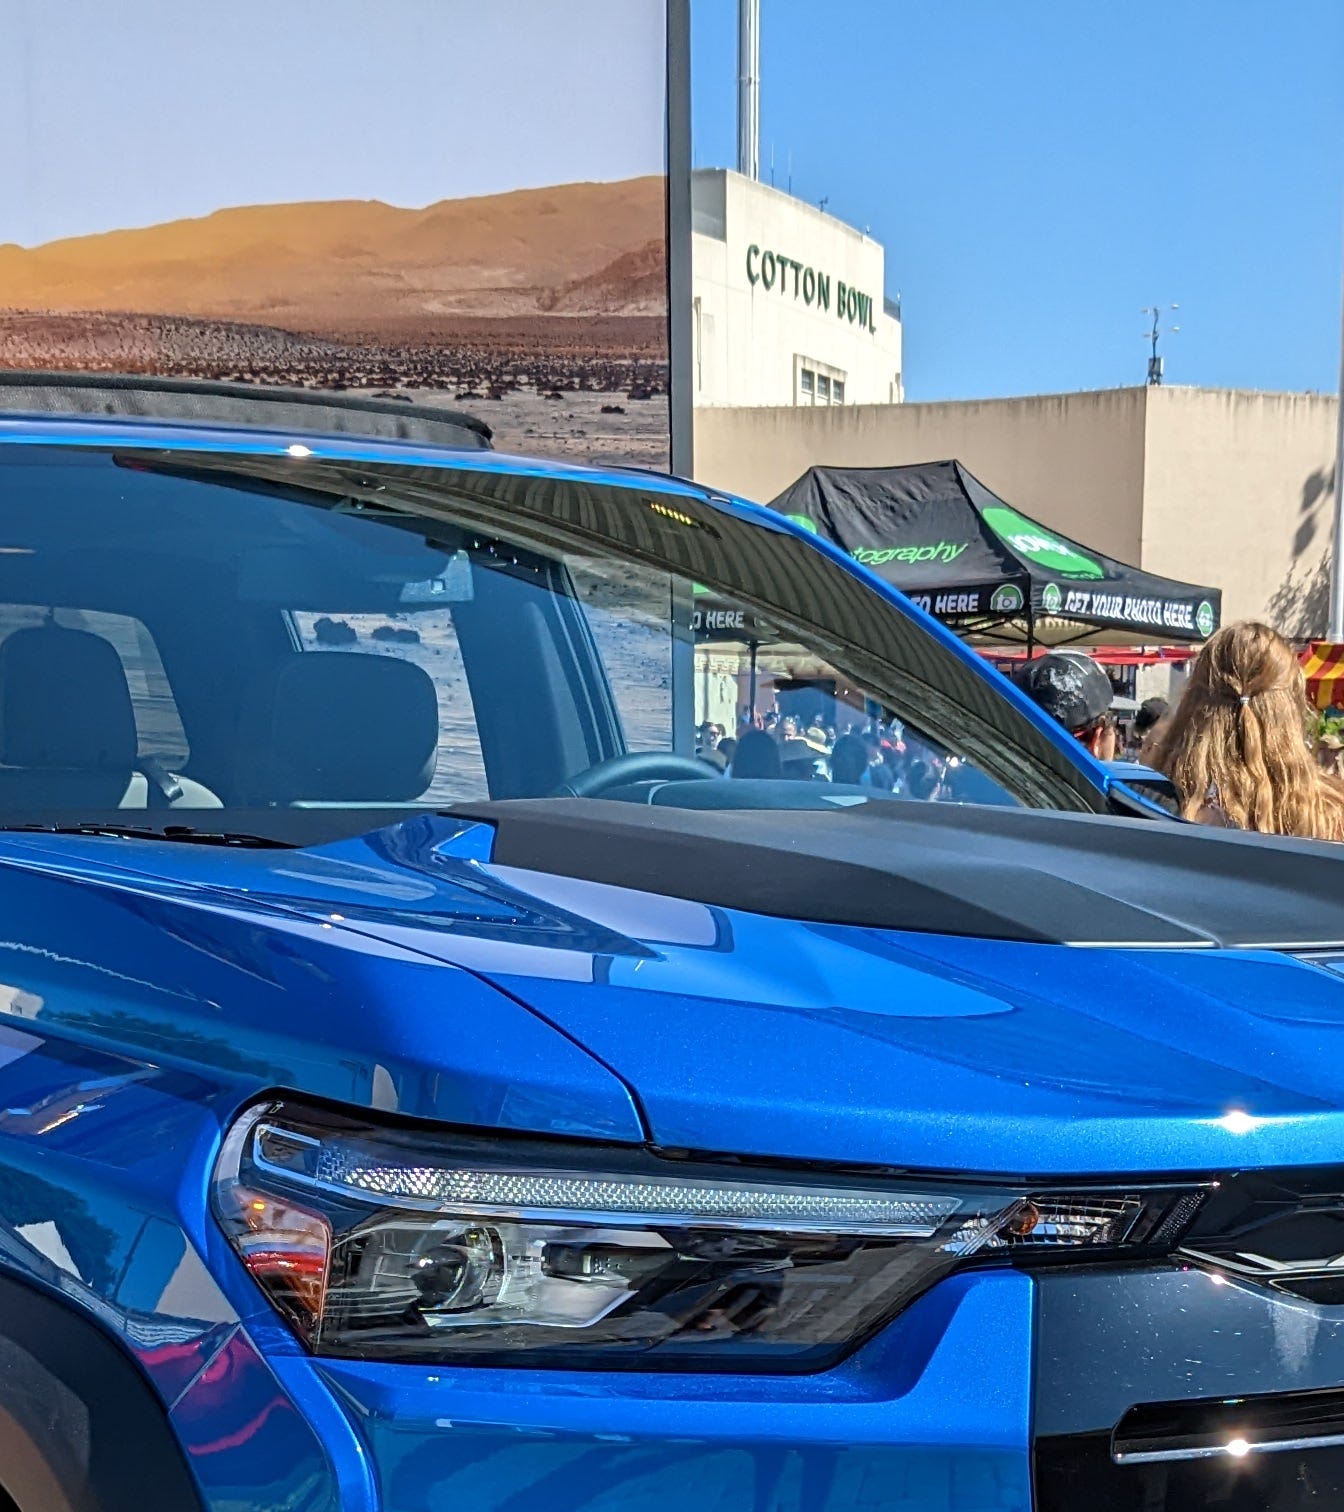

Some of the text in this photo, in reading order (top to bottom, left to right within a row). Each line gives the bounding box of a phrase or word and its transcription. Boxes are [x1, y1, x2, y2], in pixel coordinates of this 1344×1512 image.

[746, 243, 877, 336] COTTON BOWL
[852, 540, 969, 565] tography
[934, 594, 979, 614] HERE
[1091, 593, 1124, 619] YOUR
[1123, 598, 1163, 625] PHOTO
[1163, 602, 1194, 629] HERE
[705, 611, 745, 629] HERE
